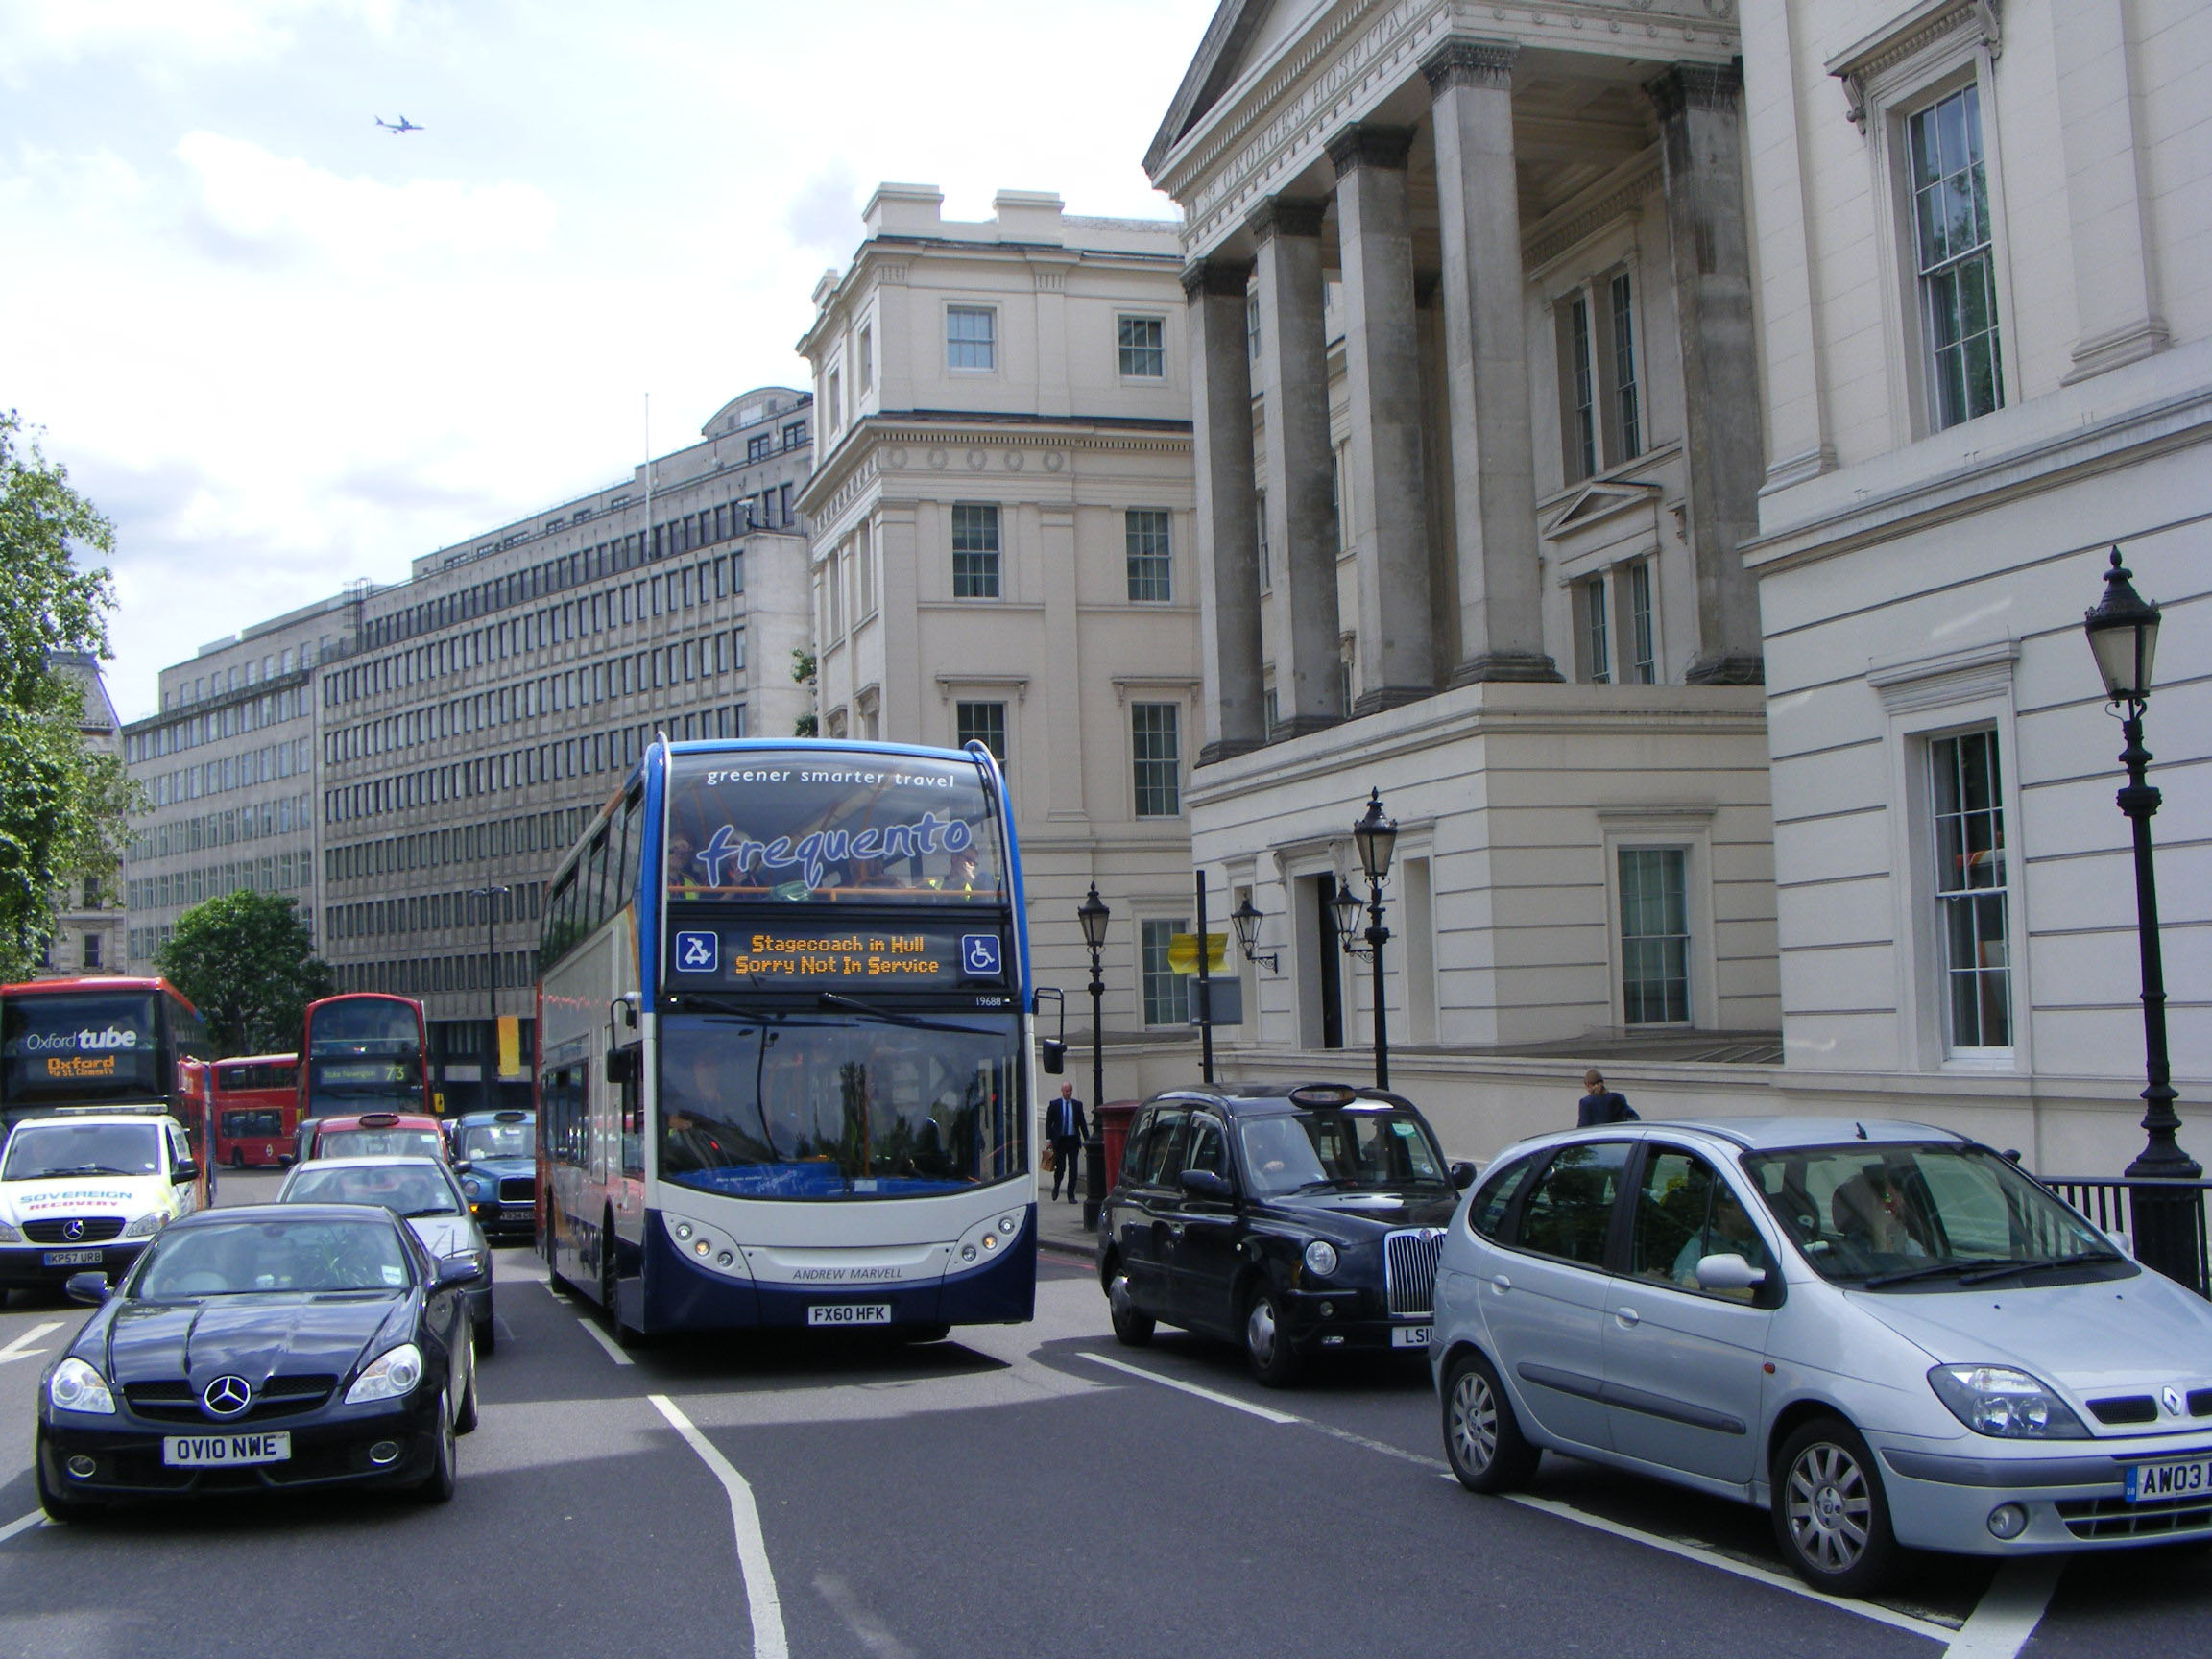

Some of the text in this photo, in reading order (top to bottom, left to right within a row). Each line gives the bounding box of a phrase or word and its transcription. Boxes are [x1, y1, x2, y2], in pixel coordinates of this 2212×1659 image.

[708, 770, 954, 787] greener smarter travel
[696, 811, 973, 891] frequento
[752, 934, 924, 953] Stagecoach in Hull
[735, 955, 940, 974] Sorry Not In Service
[975, 996, 1001, 1006] 19688
[27, 1025, 137, 1050] Oxford tube
[47, 1055, 115, 1070] Oxford
[385, 1065, 405, 1082] 73
[20, 1190, 133, 1204] SOVEREIGN
[29, 1200, 118, 1211] RECOVERY
[52, 1252, 78, 1264] KP57
[793, 1267, 902, 1281] ANDREW MARVELL
[814, 1306, 884, 1321] FX60 HFK
[177, 1434, 276, 1459] OV10 NWE
[2143, 1464, 2201, 1494] AW03
